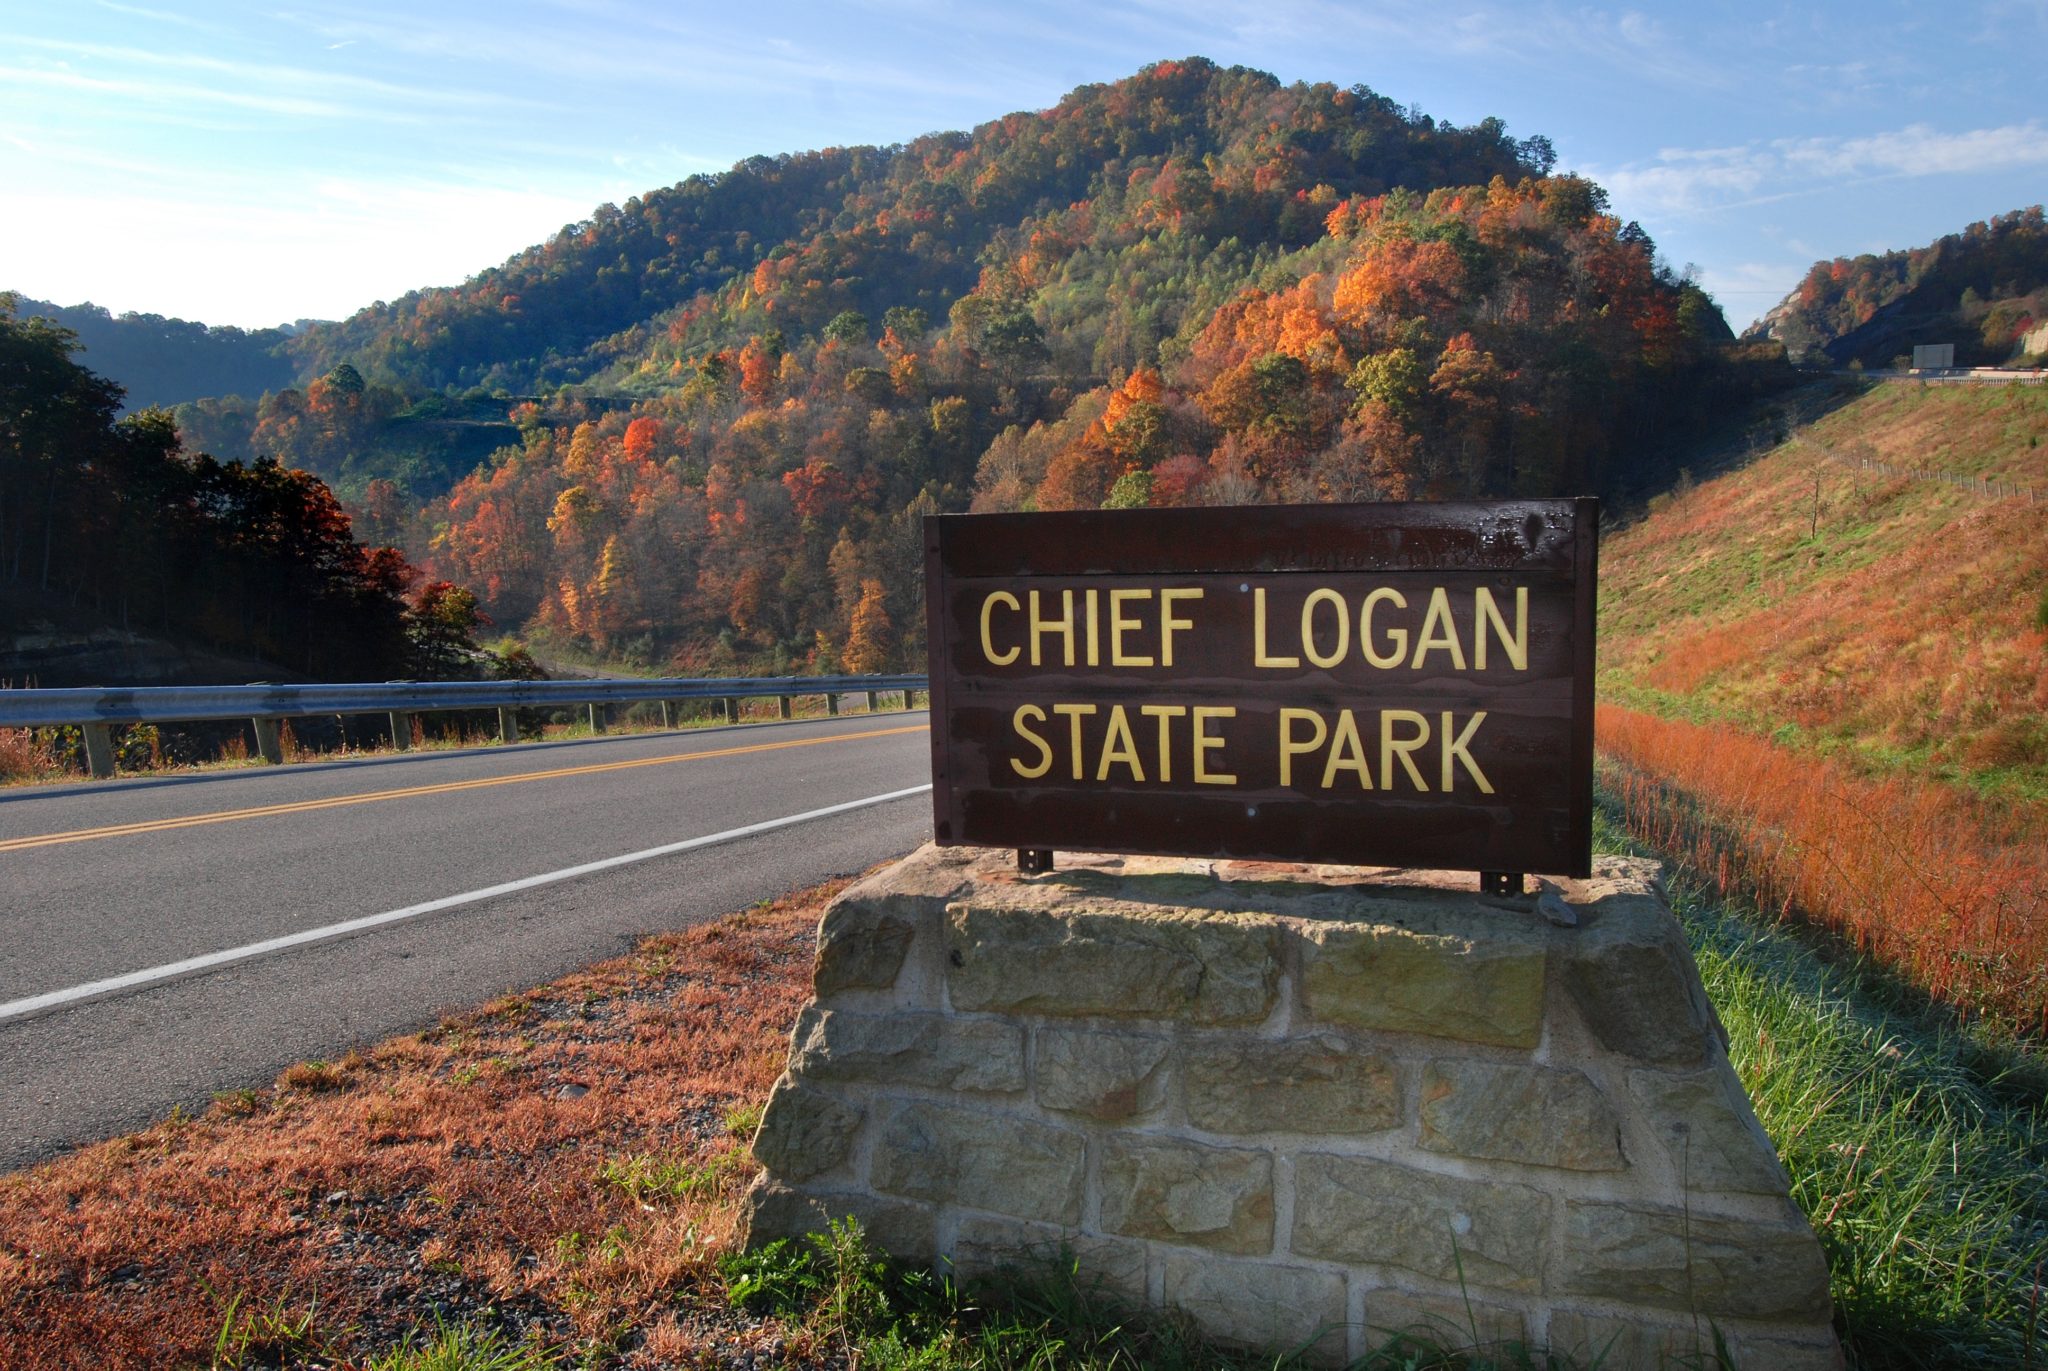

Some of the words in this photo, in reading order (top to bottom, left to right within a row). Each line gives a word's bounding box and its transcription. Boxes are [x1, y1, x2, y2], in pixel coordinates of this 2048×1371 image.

[980, 587, 1204, 667] CHIEF
[1254, 587, 1528, 670] LOGAN
[1011, 704, 1237, 785] STATE
[1279, 708, 1495, 794] PARK
